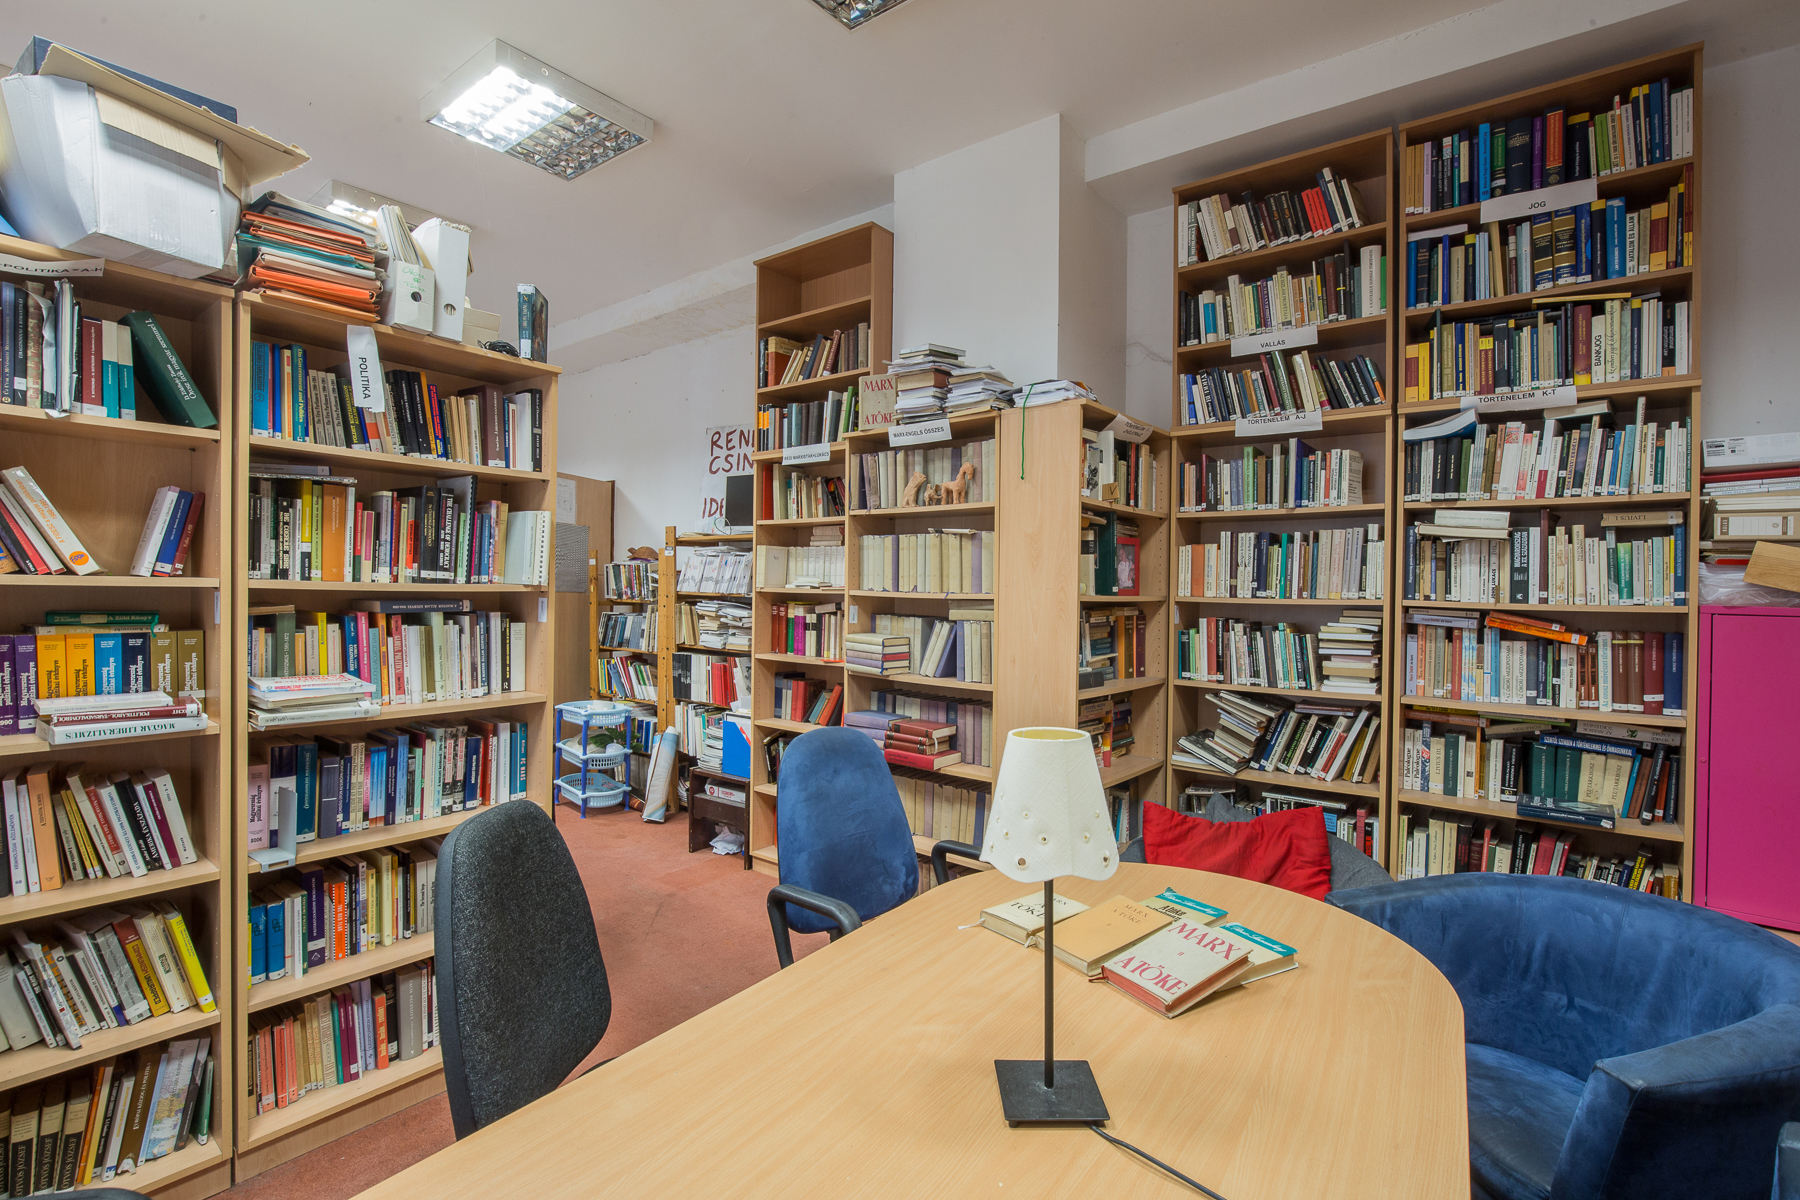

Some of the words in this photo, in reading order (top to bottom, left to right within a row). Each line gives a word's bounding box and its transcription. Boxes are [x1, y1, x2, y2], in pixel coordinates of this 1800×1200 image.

[1528, 201, 1546, 210] JOG
[1628, 240, 1636, 262] HATALOM
[148, 324, 167, 348] szemmel
[1260, 339, 1286, 348] VALLÁS
[164, 349, 180, 370] magyar
[1594, 334, 1603, 366] BANKJOG
[177, 370, 188, 382] írók
[358, 357, 371, 400] POLITIKA
[864, 378, 894, 392] MARX
[183, 382, 196, 399] Orosz
[1478, 392, 1535, 403] TÖRTÉNELEM
[864, 415, 870, 425] A
[870, 410, 894, 424] TŐKE
[711, 429, 754, 456] REN
[893, 430, 923, 438] MARX-ENGELS
[924, 426, 944, 436] ÖSSZES
[1570, 437, 1578, 459] ERDÉLY
[15, 479, 37, 503] politikában
[34, 503, 49, 519] magyar
[47, 523, 62, 539] FIDESZ
[1513, 532, 1521, 567] MAGYARORSZÁG
[1601, 661, 1610, 684] művészet
[1600, 685, 1609, 699] orosz
[65, 726, 137, 739] LIBERALIZMUS
[140, 722, 176, 732] MAGYAR
[1542, 735, 1557, 745] SZEMTŐL
[1557, 737, 1572, 747] SZEMBEN
[1575, 740, 1601, 751] TÖRTÉNELEMMEL
[1606, 744, 1633, 755] ÖNMAGUNKKAL
[1435, 758, 1443, 774] LIVIUS
[1585, 762, 1596, 798] PLUTARKHOSZ
[1611, 764, 1622, 800] PLUTARKHOSZ
[8, 814, 16, 841] KÖZLEMÉNYEK
[132, 801, 149, 833] ÉVSZÁZADA
[143, 832, 160, 860] AMERIKA
[1118, 911, 1143, 924] TŐKE
[1124, 904, 1150, 918] MARX
[1167, 922, 1241, 960] MARX
[132, 943, 150, 975] COMMUNISM
[144, 973, 163, 1005] UNWRAPPED
[1114, 955, 1136, 969] A
[1128, 960, 1188, 995] TŐKE
[132, 1108, 143, 1130] EURÓPAI
[42, 1138, 54, 1164] JÓZSEF
[65, 1136, 78, 1163] JÓZSEF
